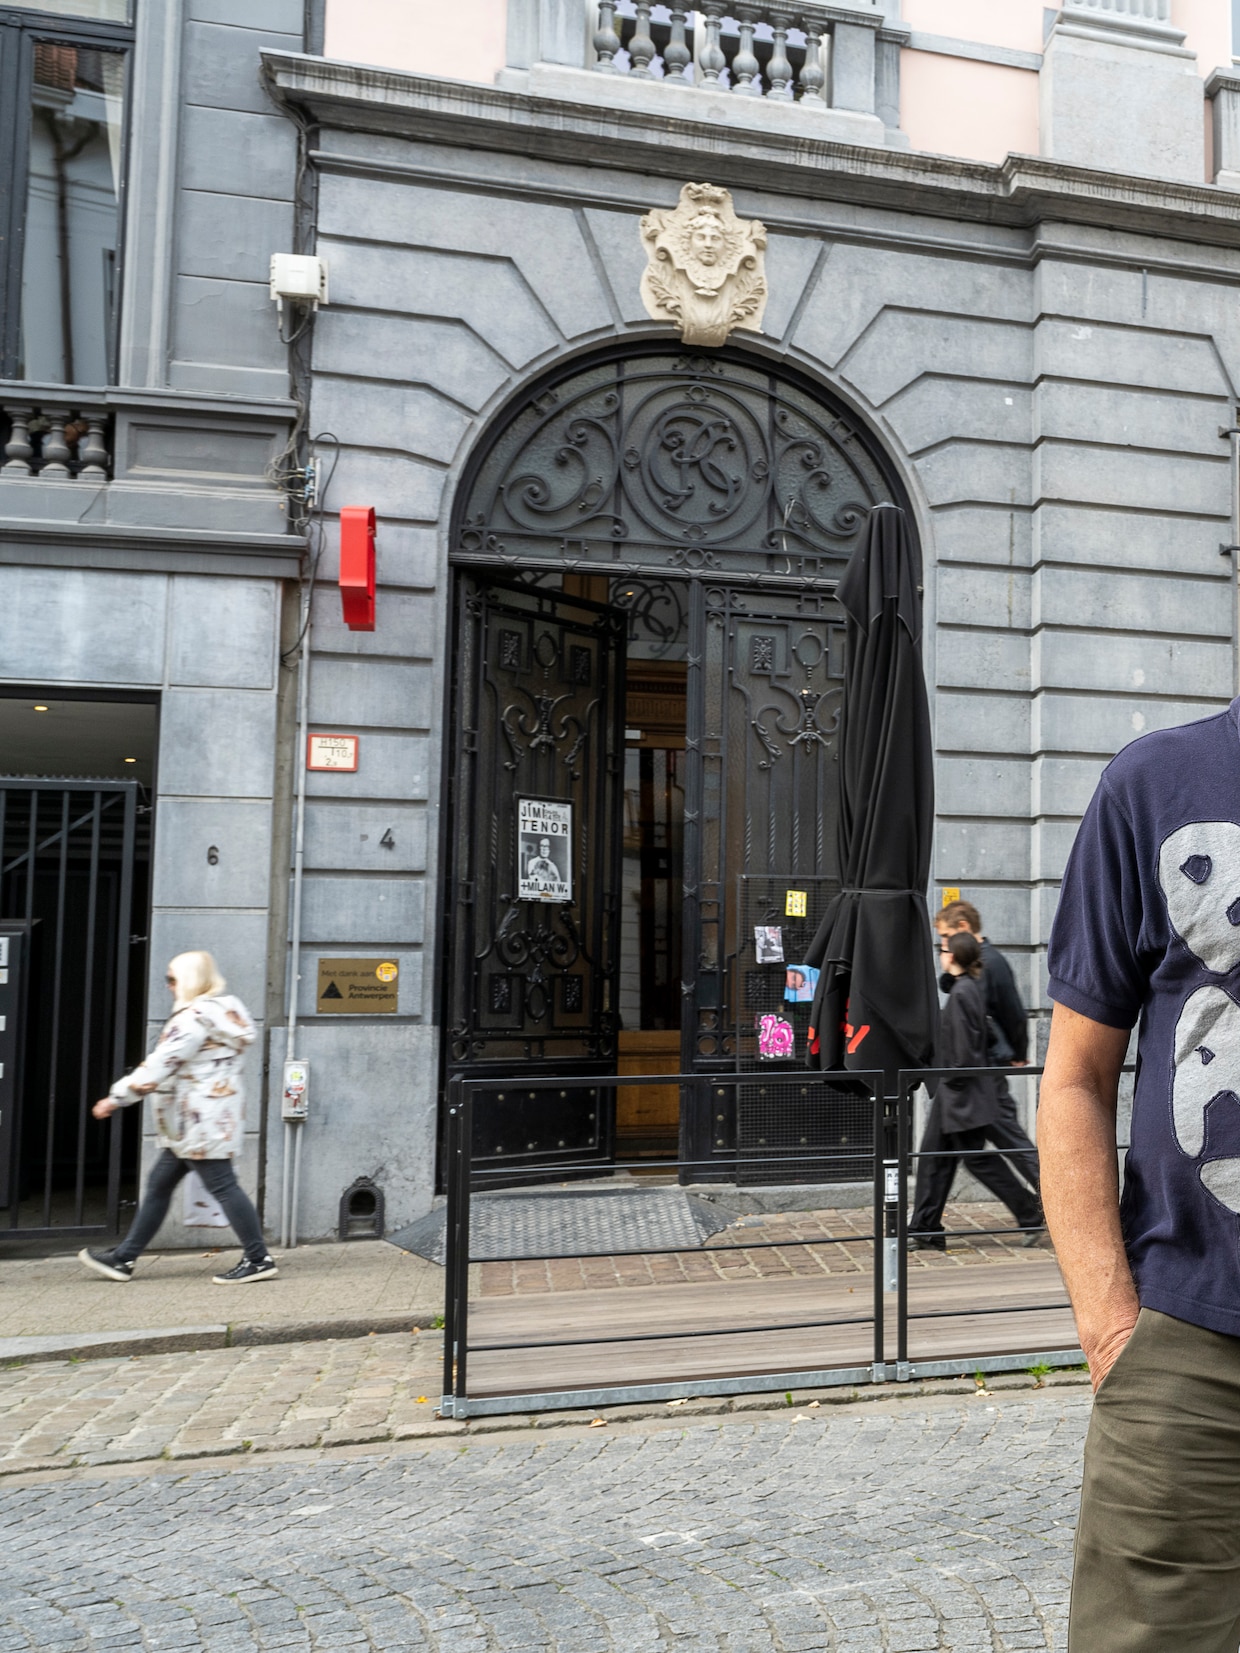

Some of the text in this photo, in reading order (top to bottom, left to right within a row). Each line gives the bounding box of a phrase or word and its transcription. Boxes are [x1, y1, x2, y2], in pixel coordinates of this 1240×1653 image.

[521, 819, 568, 834] TENOR
[380, 828, 395, 850] 4
[207, 845, 219, 866] 6
[348, 984, 388, 992] Provincie
[348, 992, 396, 1001] Antwerpen
